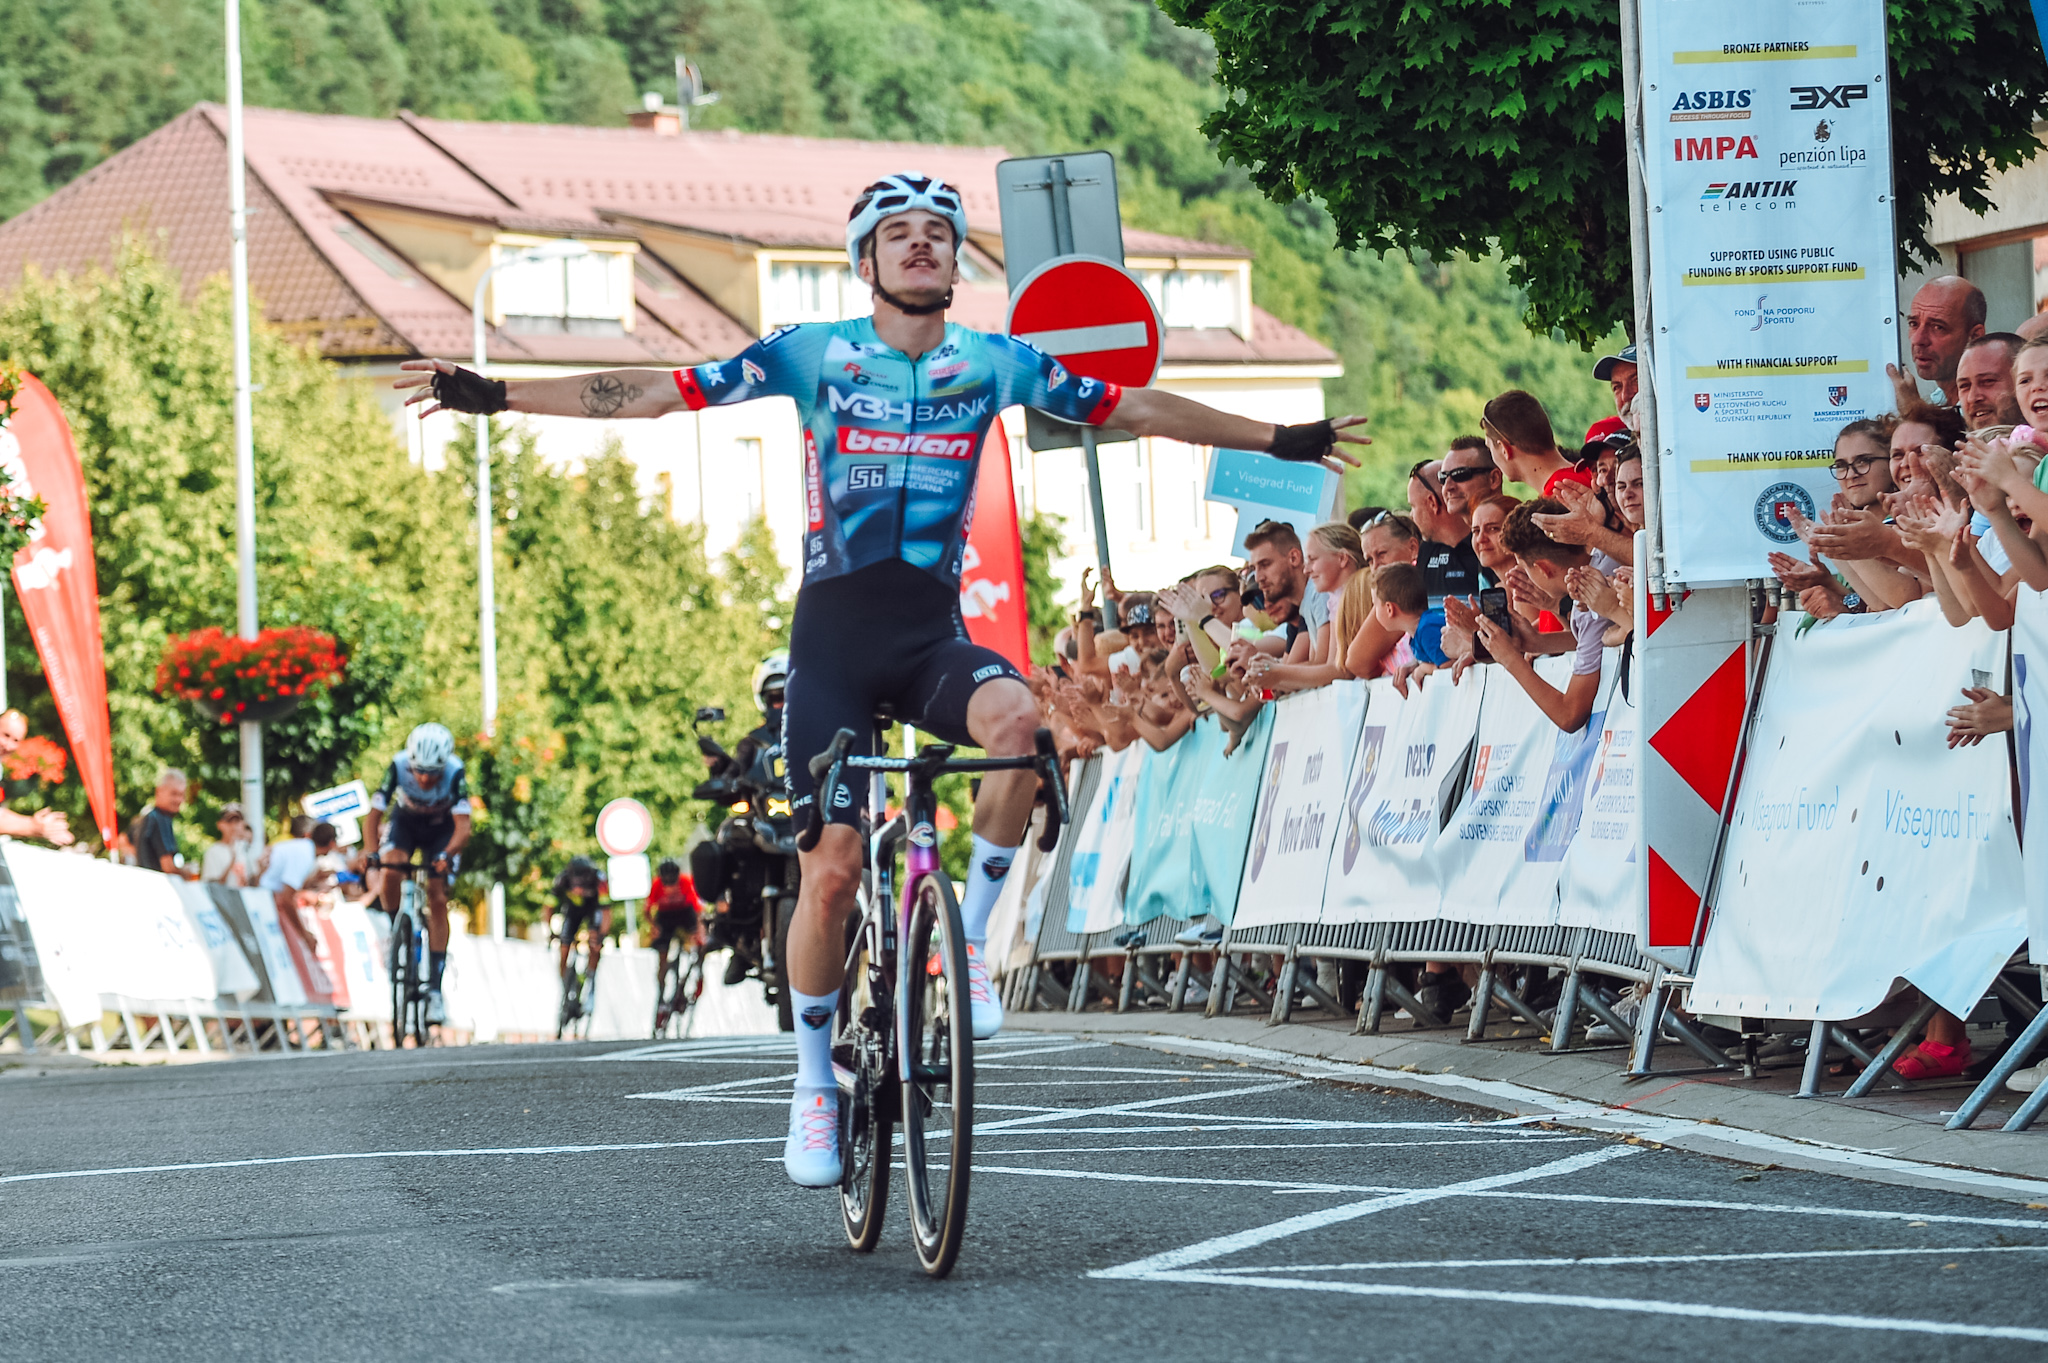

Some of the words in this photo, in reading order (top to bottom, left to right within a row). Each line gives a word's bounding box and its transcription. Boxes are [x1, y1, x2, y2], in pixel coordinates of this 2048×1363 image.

[1723, 43, 1761, 54] BRONZE
[1764, 41, 1809, 53] PARTNERS
[1672, 89, 1751, 110] ASBIS
[1674, 135, 1759, 161] IMPA
[1780, 147, 1836, 168] penzión
[1840, 146, 1866, 165] lipa
[1725, 180, 1798, 199] ANTIK
[1700, 200, 1797, 213] telecom
[1710, 250, 1765, 262] SUPPORTED
[1768, 248, 1798, 260] USING
[1801, 247, 1835, 258] PUBLIC
[1688, 267, 1732, 279] FUNDING
[1735, 266, 1747, 276] BY
[1749, 265, 1784, 276] SPORTS
[1786, 263, 1829, 275] SUPPORT
[1832, 262, 1858, 273] FUND
[1777, 307, 1815, 315] PODPORU
[1763, 316, 1795, 324] ŠPORTU
[1717, 358, 1742, 370] WITH
[1745, 356, 1793, 369] FINANCIAL
[1795, 355, 1838, 367] SUPPORT
[1713, 390, 1764, 398] MINISTERSTVO
[915, 394, 990, 422] BANK
[846, 429, 971, 457] ballan
[1727, 453, 1760, 464] THANK
[1762, 452, 1782, 462] YOU
[1784, 450, 1803, 461] FOR
[1805, 449, 1837, 460] SAFETY
[889, 463, 961, 481] COMERCIALE
[888, 479, 944, 494] BRSCIANA
[1238, 470, 1284, 489] Visegrad
[1286, 480, 1313, 495] Fund
[1751, 786, 1797, 842] Visegrad
[1797, 785, 1839, 831] Fund
[1884, 789, 1961, 849] Visegrad
